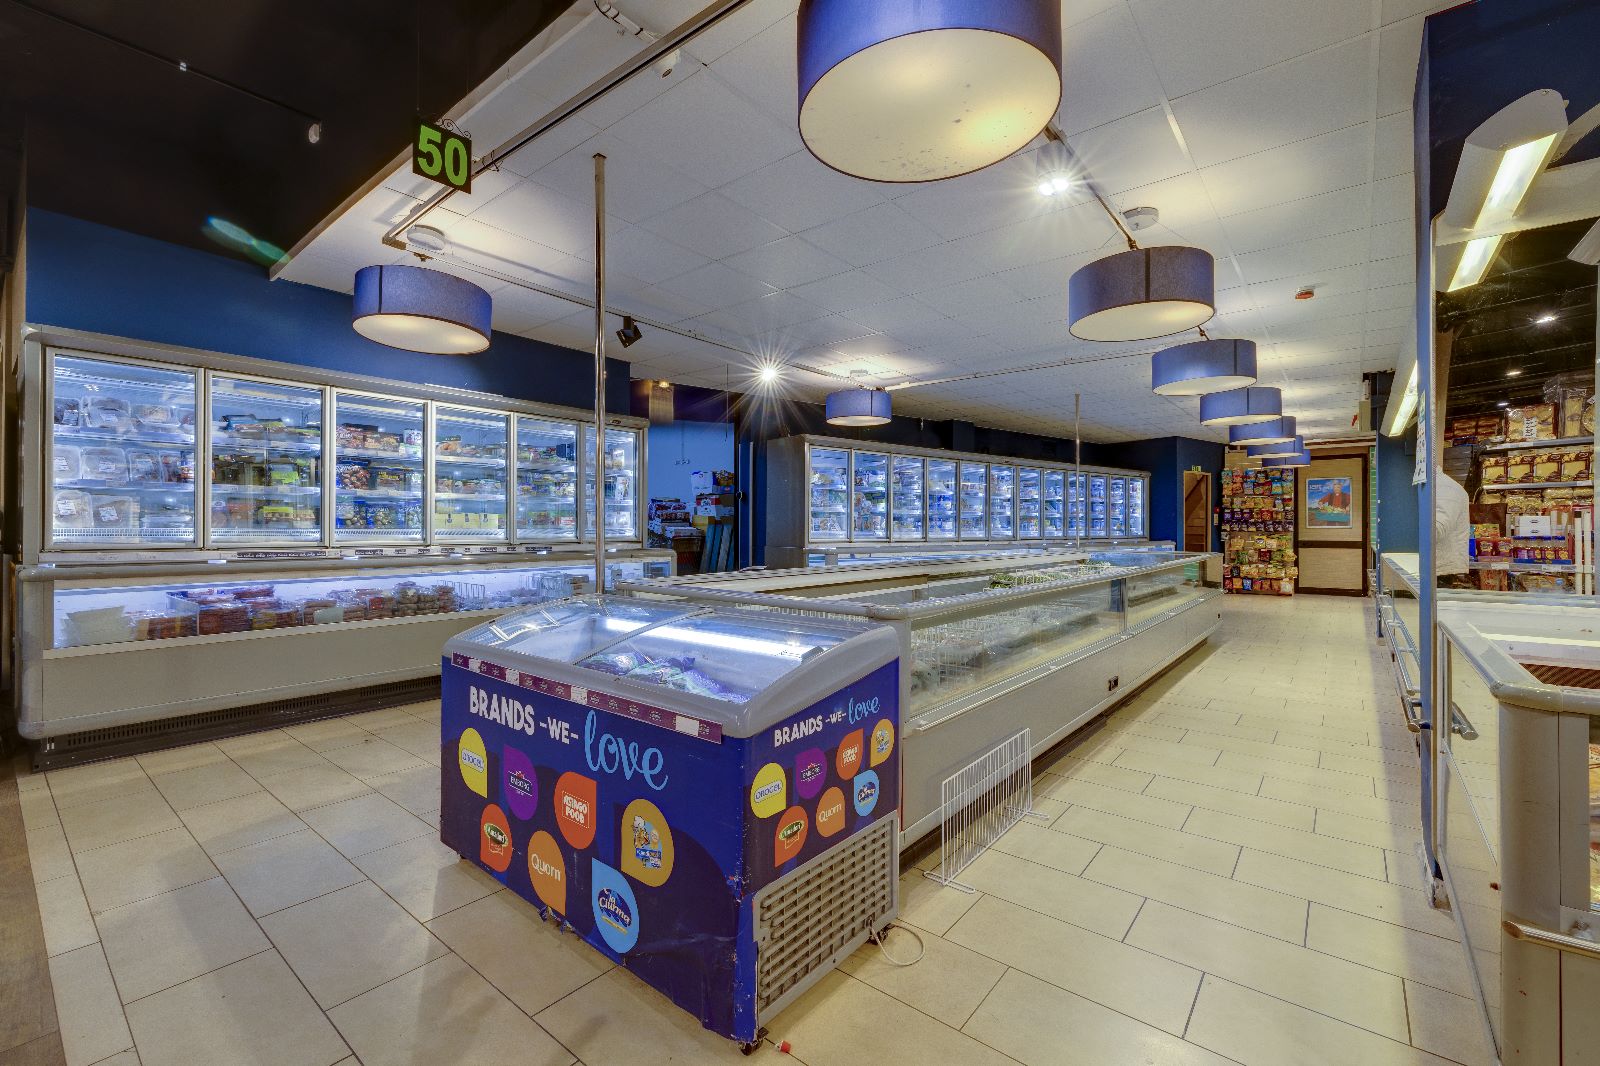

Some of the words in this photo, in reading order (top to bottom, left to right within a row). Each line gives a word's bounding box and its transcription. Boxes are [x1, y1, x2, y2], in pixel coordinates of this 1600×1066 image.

[418, 124, 467, 186] 50
[469, 686, 535, 736] BRANDS
[584, 709, 669, 791] love
[774, 715, 823, 748] BRANDS
[848, 696, 881, 725] love
[755, 781, 782, 800] OROGEL
[818, 803, 842, 823] Quorn
[531, 853, 561, 882] Quorn
